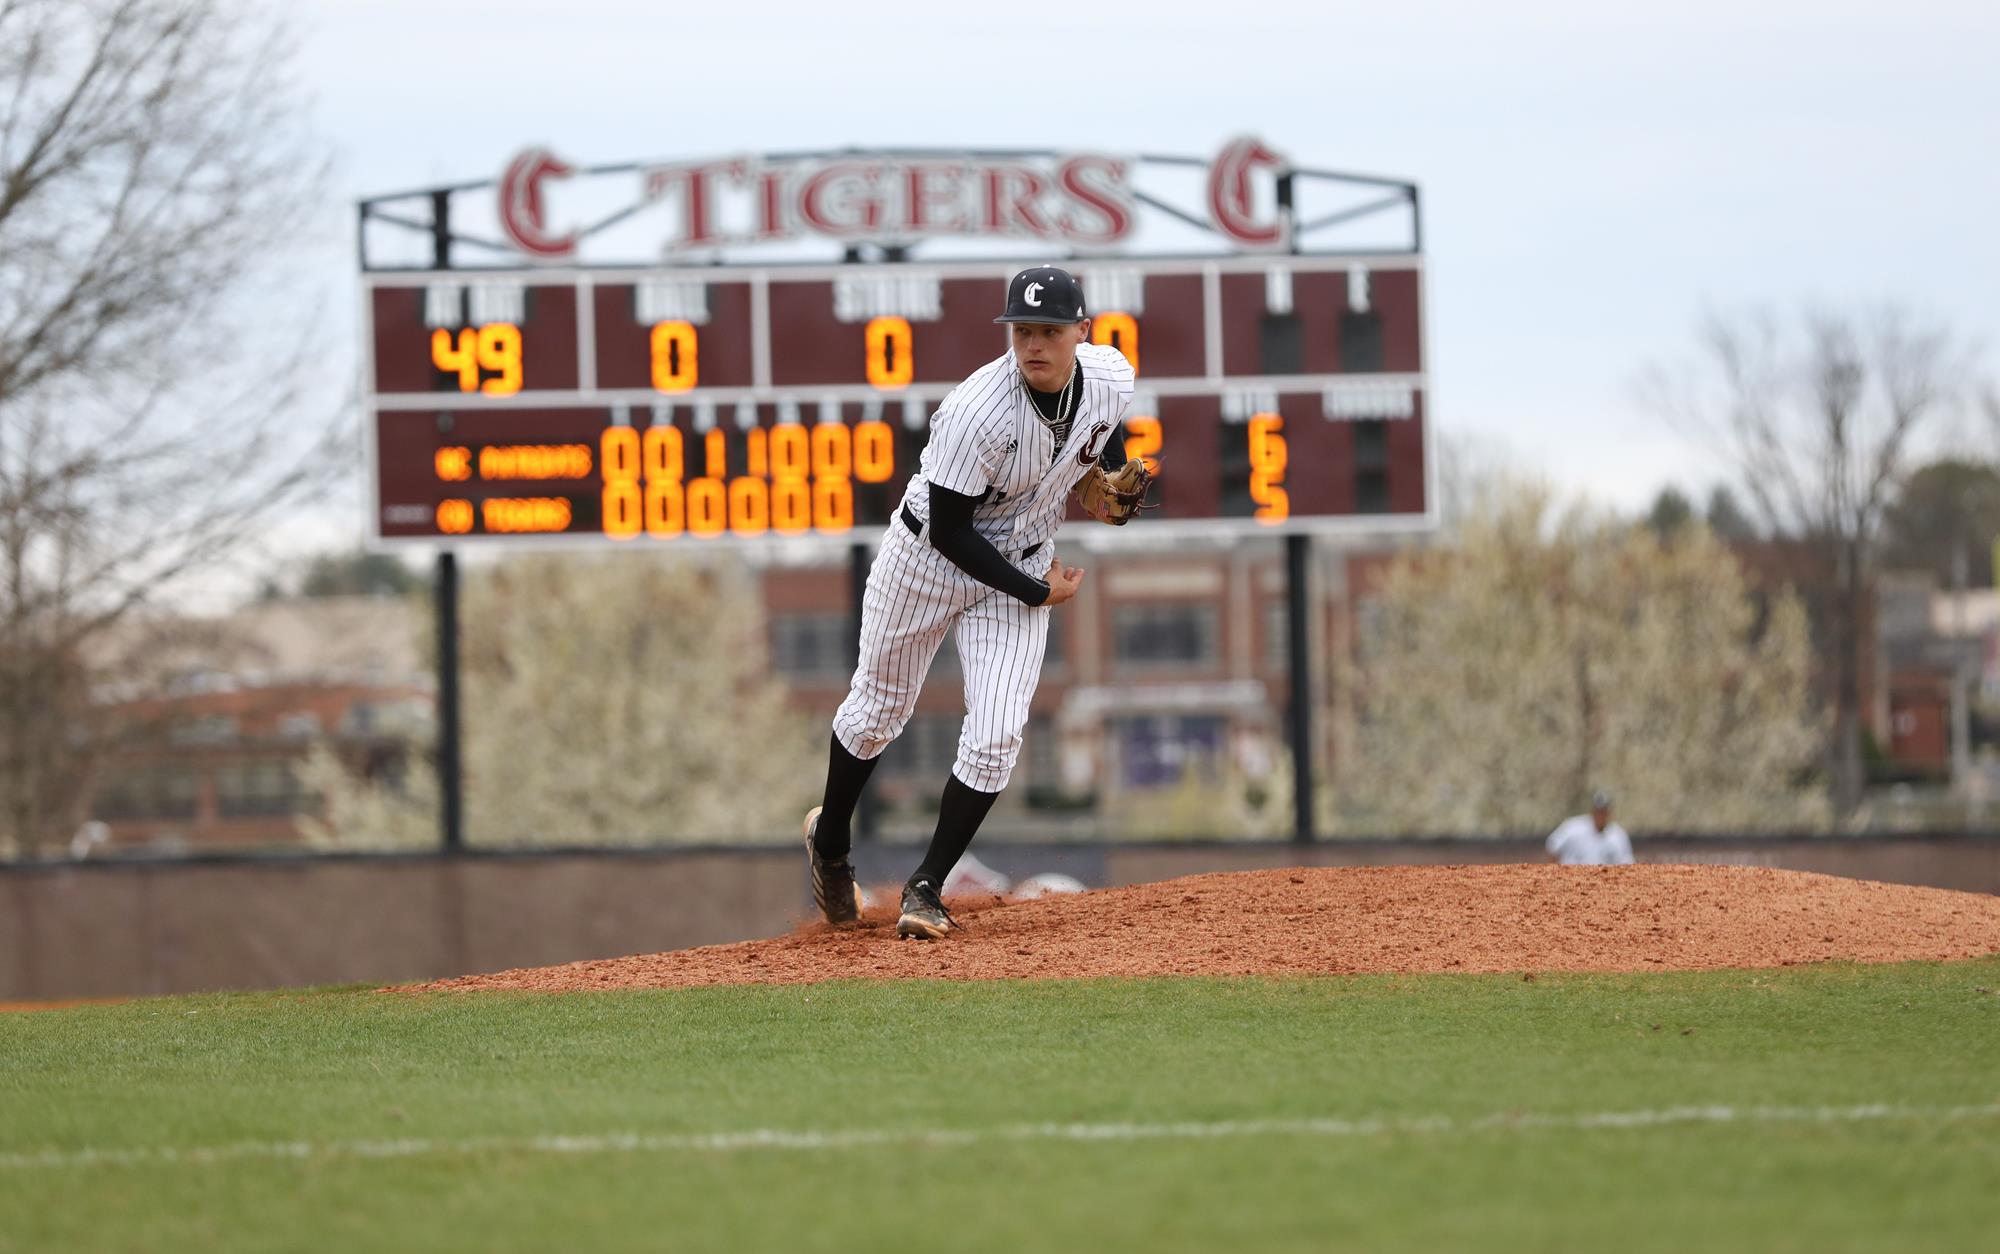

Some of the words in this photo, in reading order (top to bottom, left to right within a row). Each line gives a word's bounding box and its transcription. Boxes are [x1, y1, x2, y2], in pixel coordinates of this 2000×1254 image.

[500, 147, 578, 260] C
[645, 154, 1137, 252] TIGERS
[1208, 137, 1288, 248] C
[1024, 282, 1044, 307] C
[431, 321, 523, 396] 49
[651, 319, 698, 395] 0
[865, 315, 913, 391] 0
[1091, 311, 1139, 378] 0
[1077, 420, 1112, 466] C
[1124, 416, 1162, 477] 2
[1248, 412, 1288, 471] 6
[1250, 469, 1290, 527] 5
